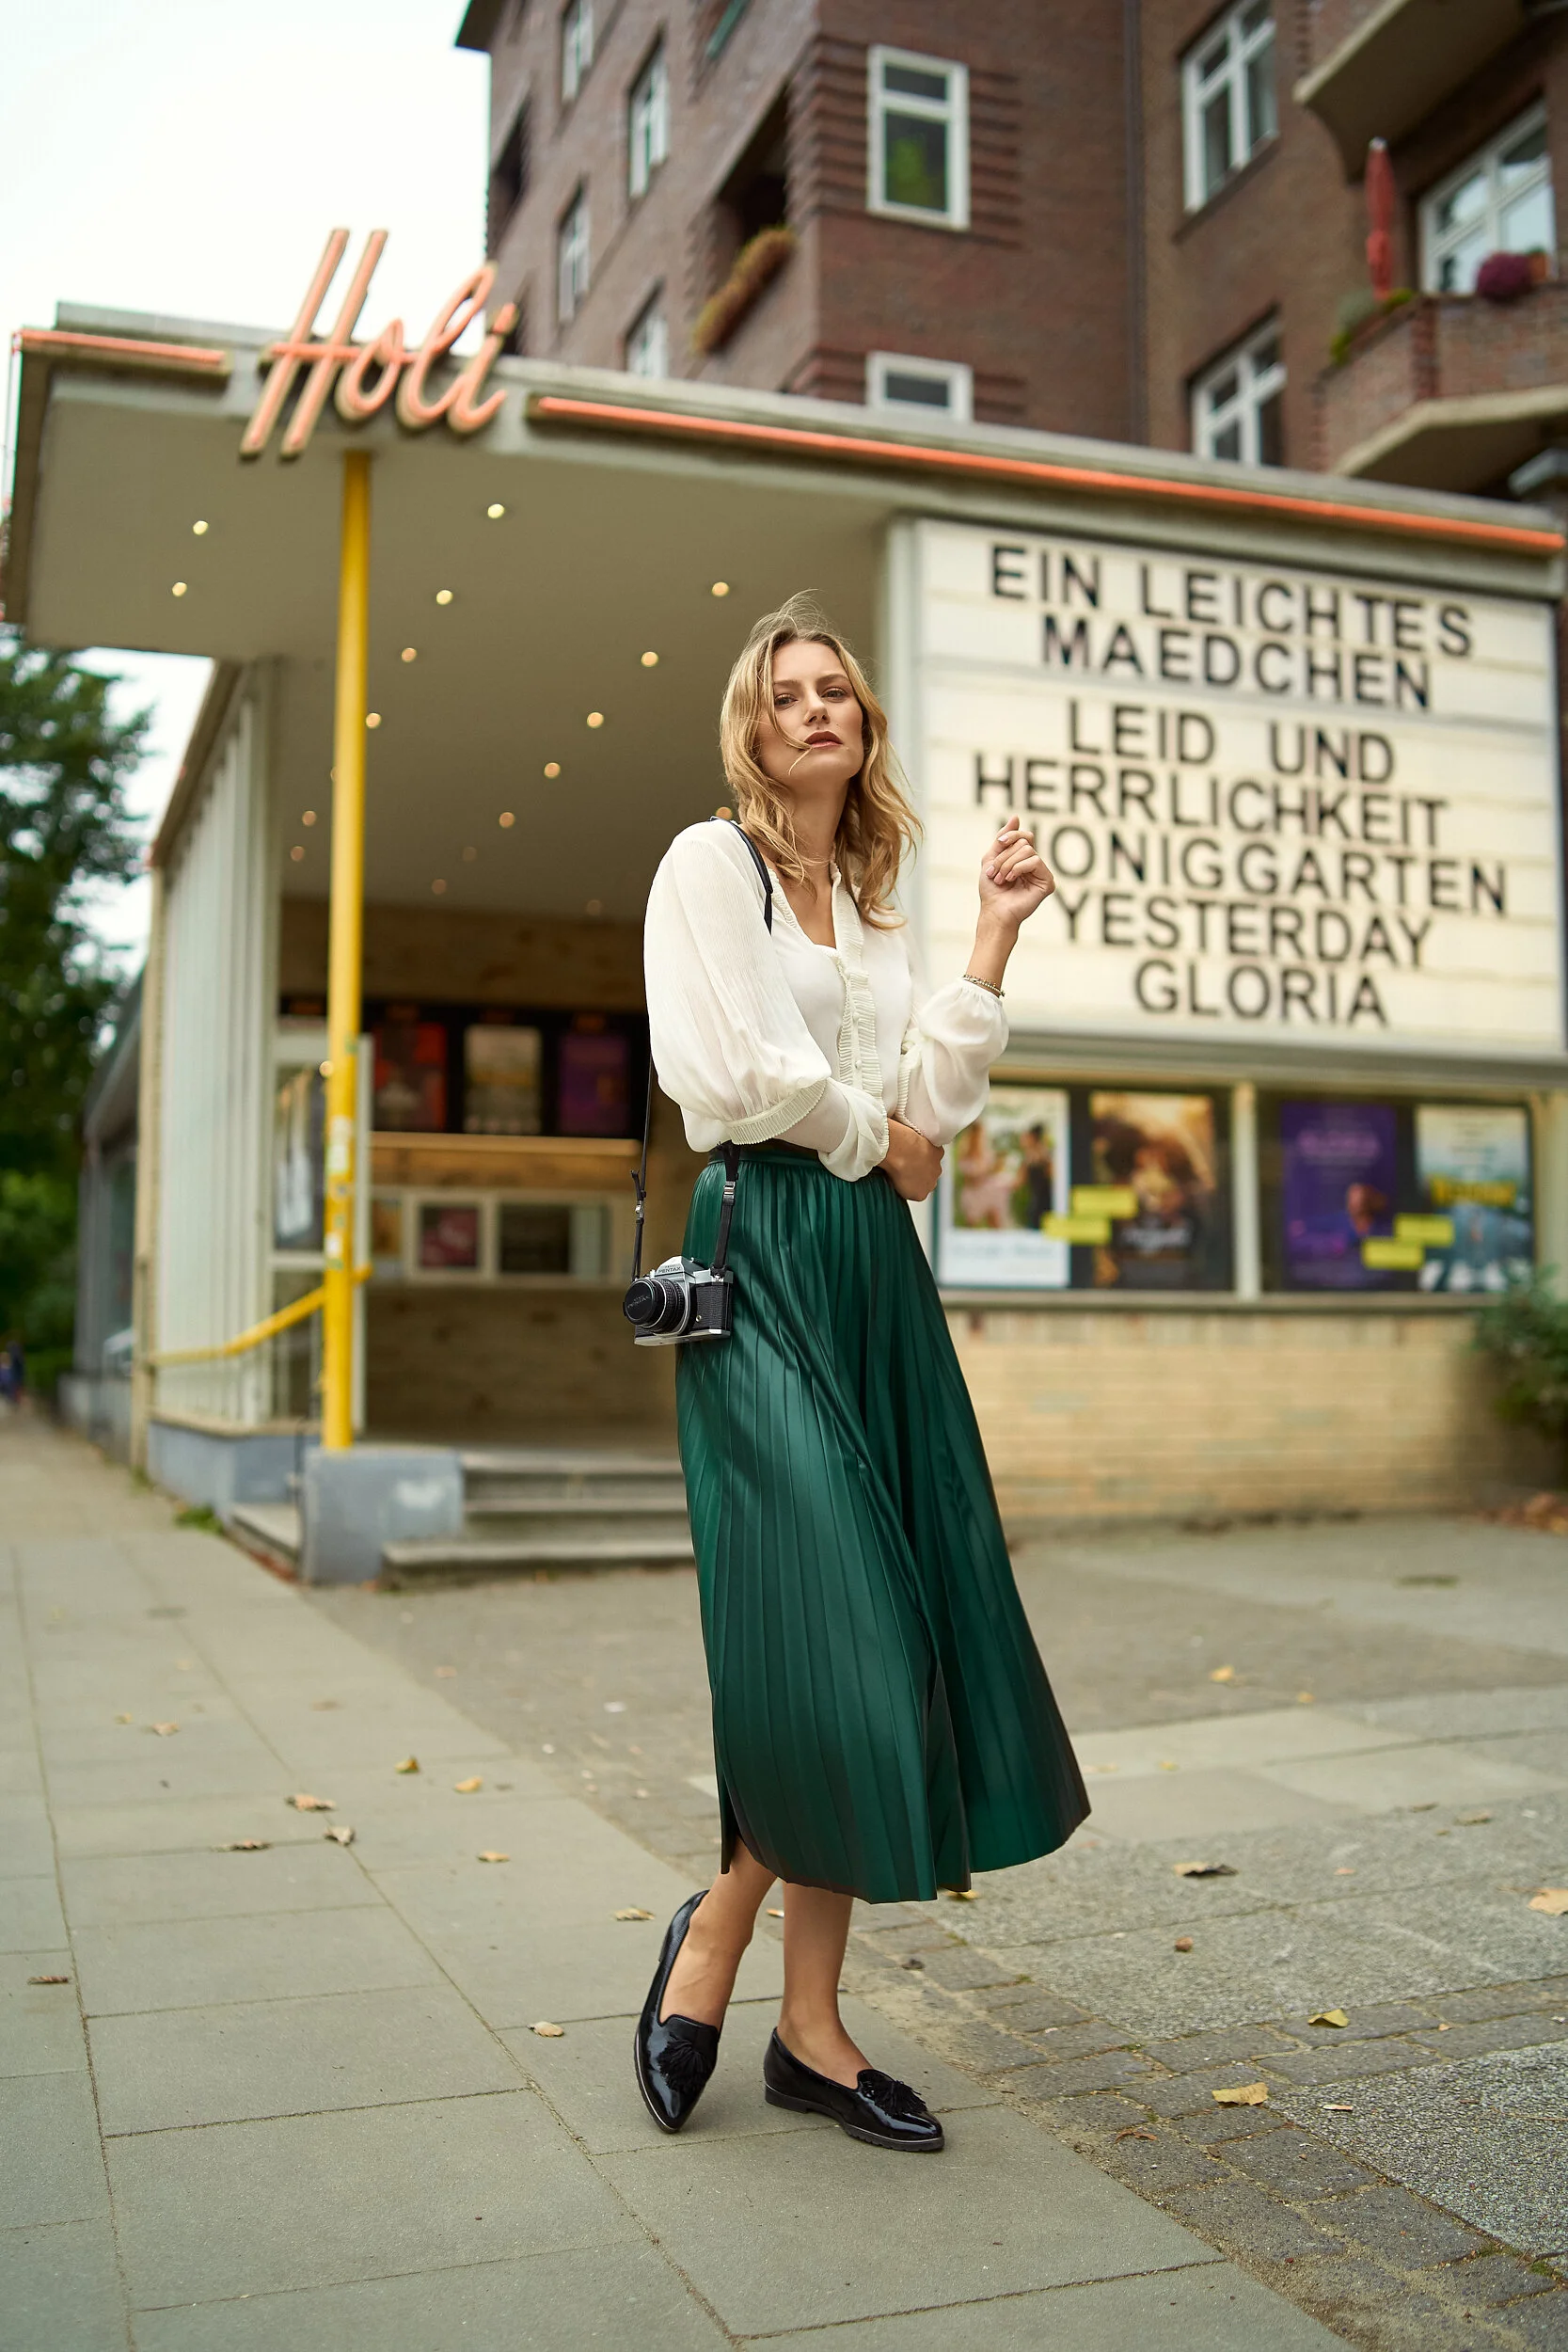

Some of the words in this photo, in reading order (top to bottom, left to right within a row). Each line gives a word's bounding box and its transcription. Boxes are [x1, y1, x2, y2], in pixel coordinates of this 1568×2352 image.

[240, 228, 517, 459] Holi
[990, 543, 1101, 610] EIN
[1140, 562, 1474, 659] LEICHTES
[1043, 614, 1431, 710] MAEDCHEN
[1069, 698, 1215, 768] LEID
[1270, 722, 1395, 785] UND
[974, 753, 1449, 849] HERRLICHKEIT
[1054, 890, 1433, 970] YESTERDAY
[1134, 959, 1387, 1026] GLORIA
